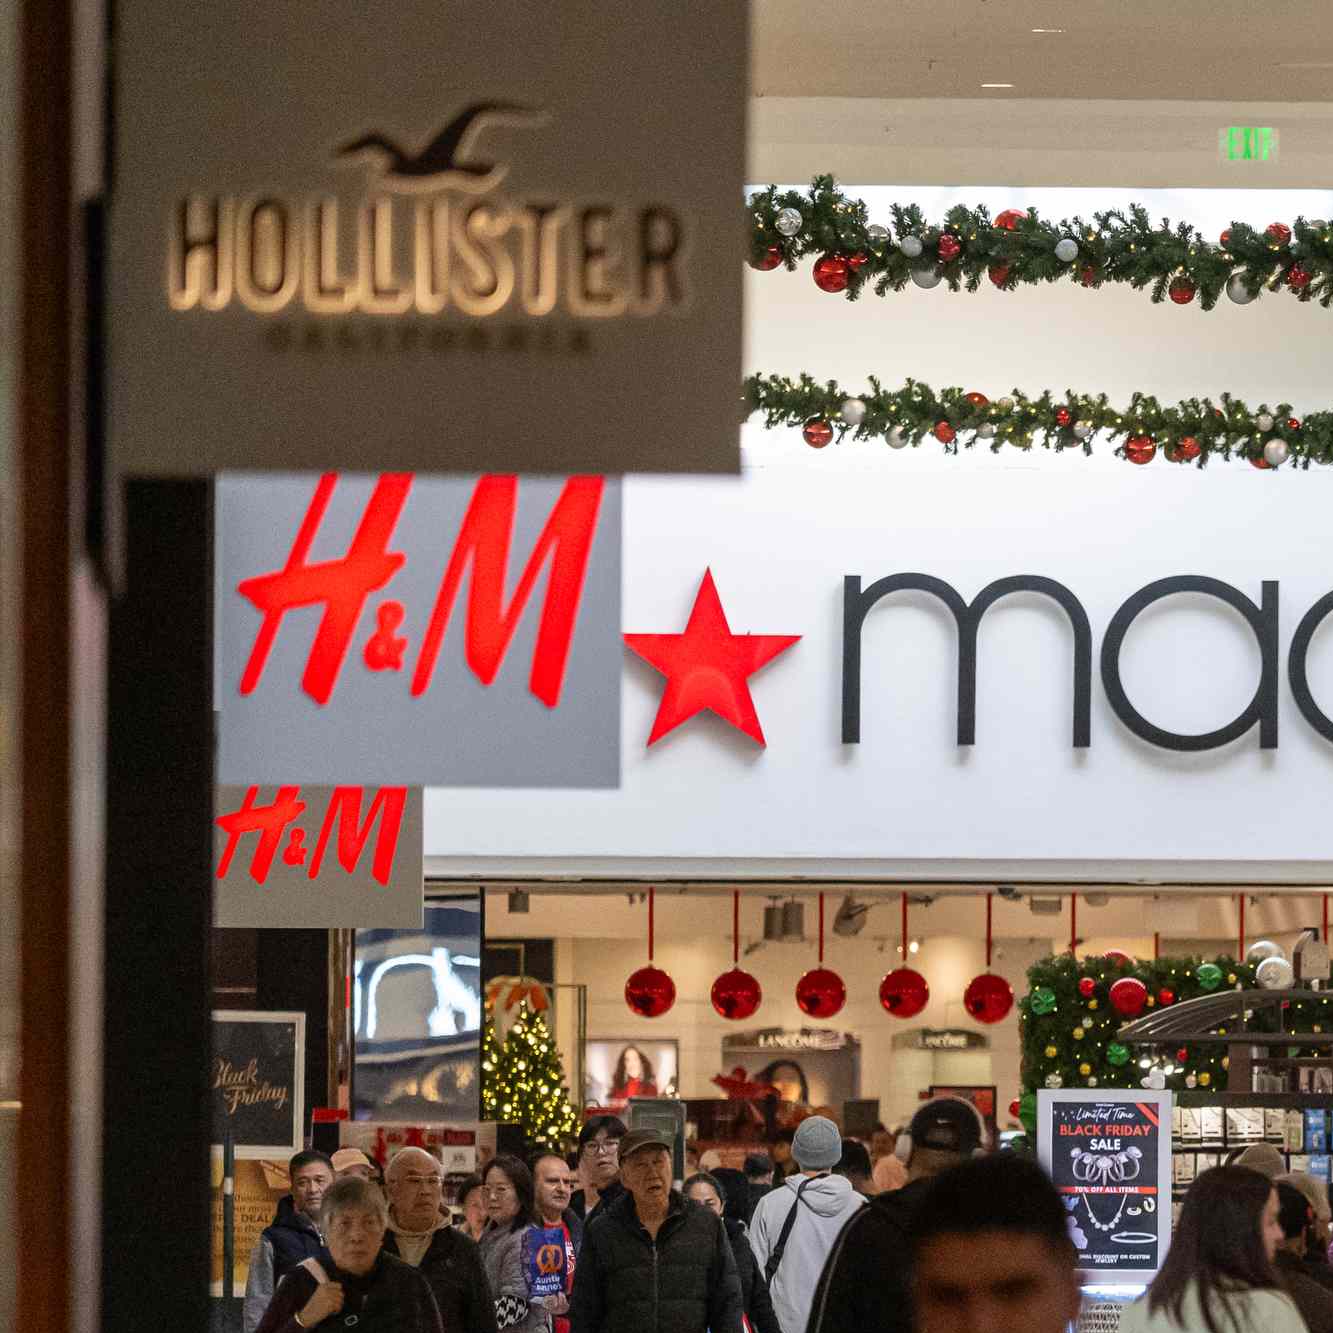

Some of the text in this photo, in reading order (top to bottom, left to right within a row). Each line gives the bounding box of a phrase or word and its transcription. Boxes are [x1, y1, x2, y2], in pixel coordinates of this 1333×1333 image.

[168, 194, 692, 316] HOLLISTER
[236, 472, 606, 709] H&M
[214, 785, 408, 888] H&M
[1075, 1107, 1136, 1122] Limited Time
[1059, 1124, 1152, 1136] BLACK FRIDAY
[1089, 1138, 1121, 1150] SALE
[1090, 1186, 1104, 1194] OFF
[1104, 1186, 1118, 1194] ALL
[1119, 1186, 1139, 1194] ITEMS
